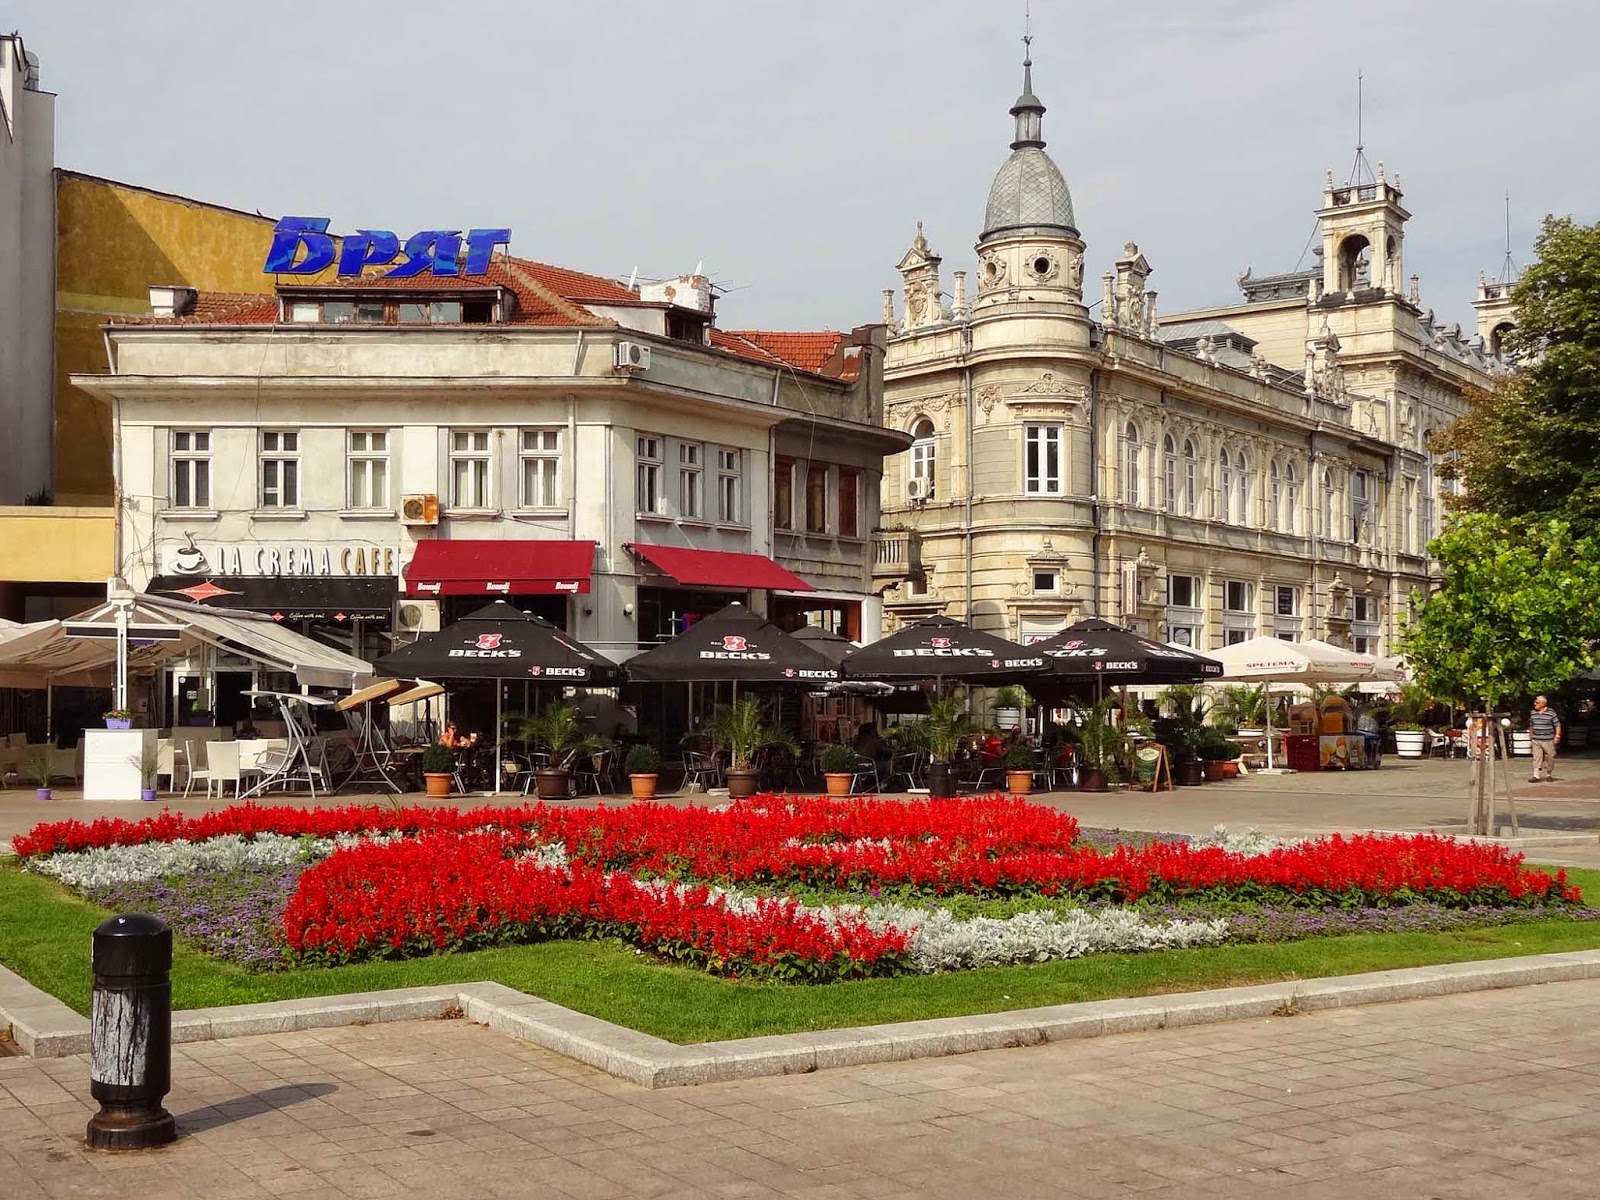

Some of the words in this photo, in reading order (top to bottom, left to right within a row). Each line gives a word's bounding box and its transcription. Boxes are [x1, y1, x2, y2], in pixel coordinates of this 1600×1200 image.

[217, 547, 242, 574] LA
[255, 547, 331, 574] CREMA
[340, 547, 393, 574] CAFE
[448, 649, 522, 658] BECK'S
[700, 650, 771, 660] BECK'S
[893, 647, 994, 657] BECK'S
[1004, 657, 1043, 668] BECK'S
[1106, 660, 1138, 670] BECK'S
[1246, 660, 1296, 668] SPETEMA
[545, 666, 586, 677] BECK'S
[799, 669, 838, 678] BECK'S
